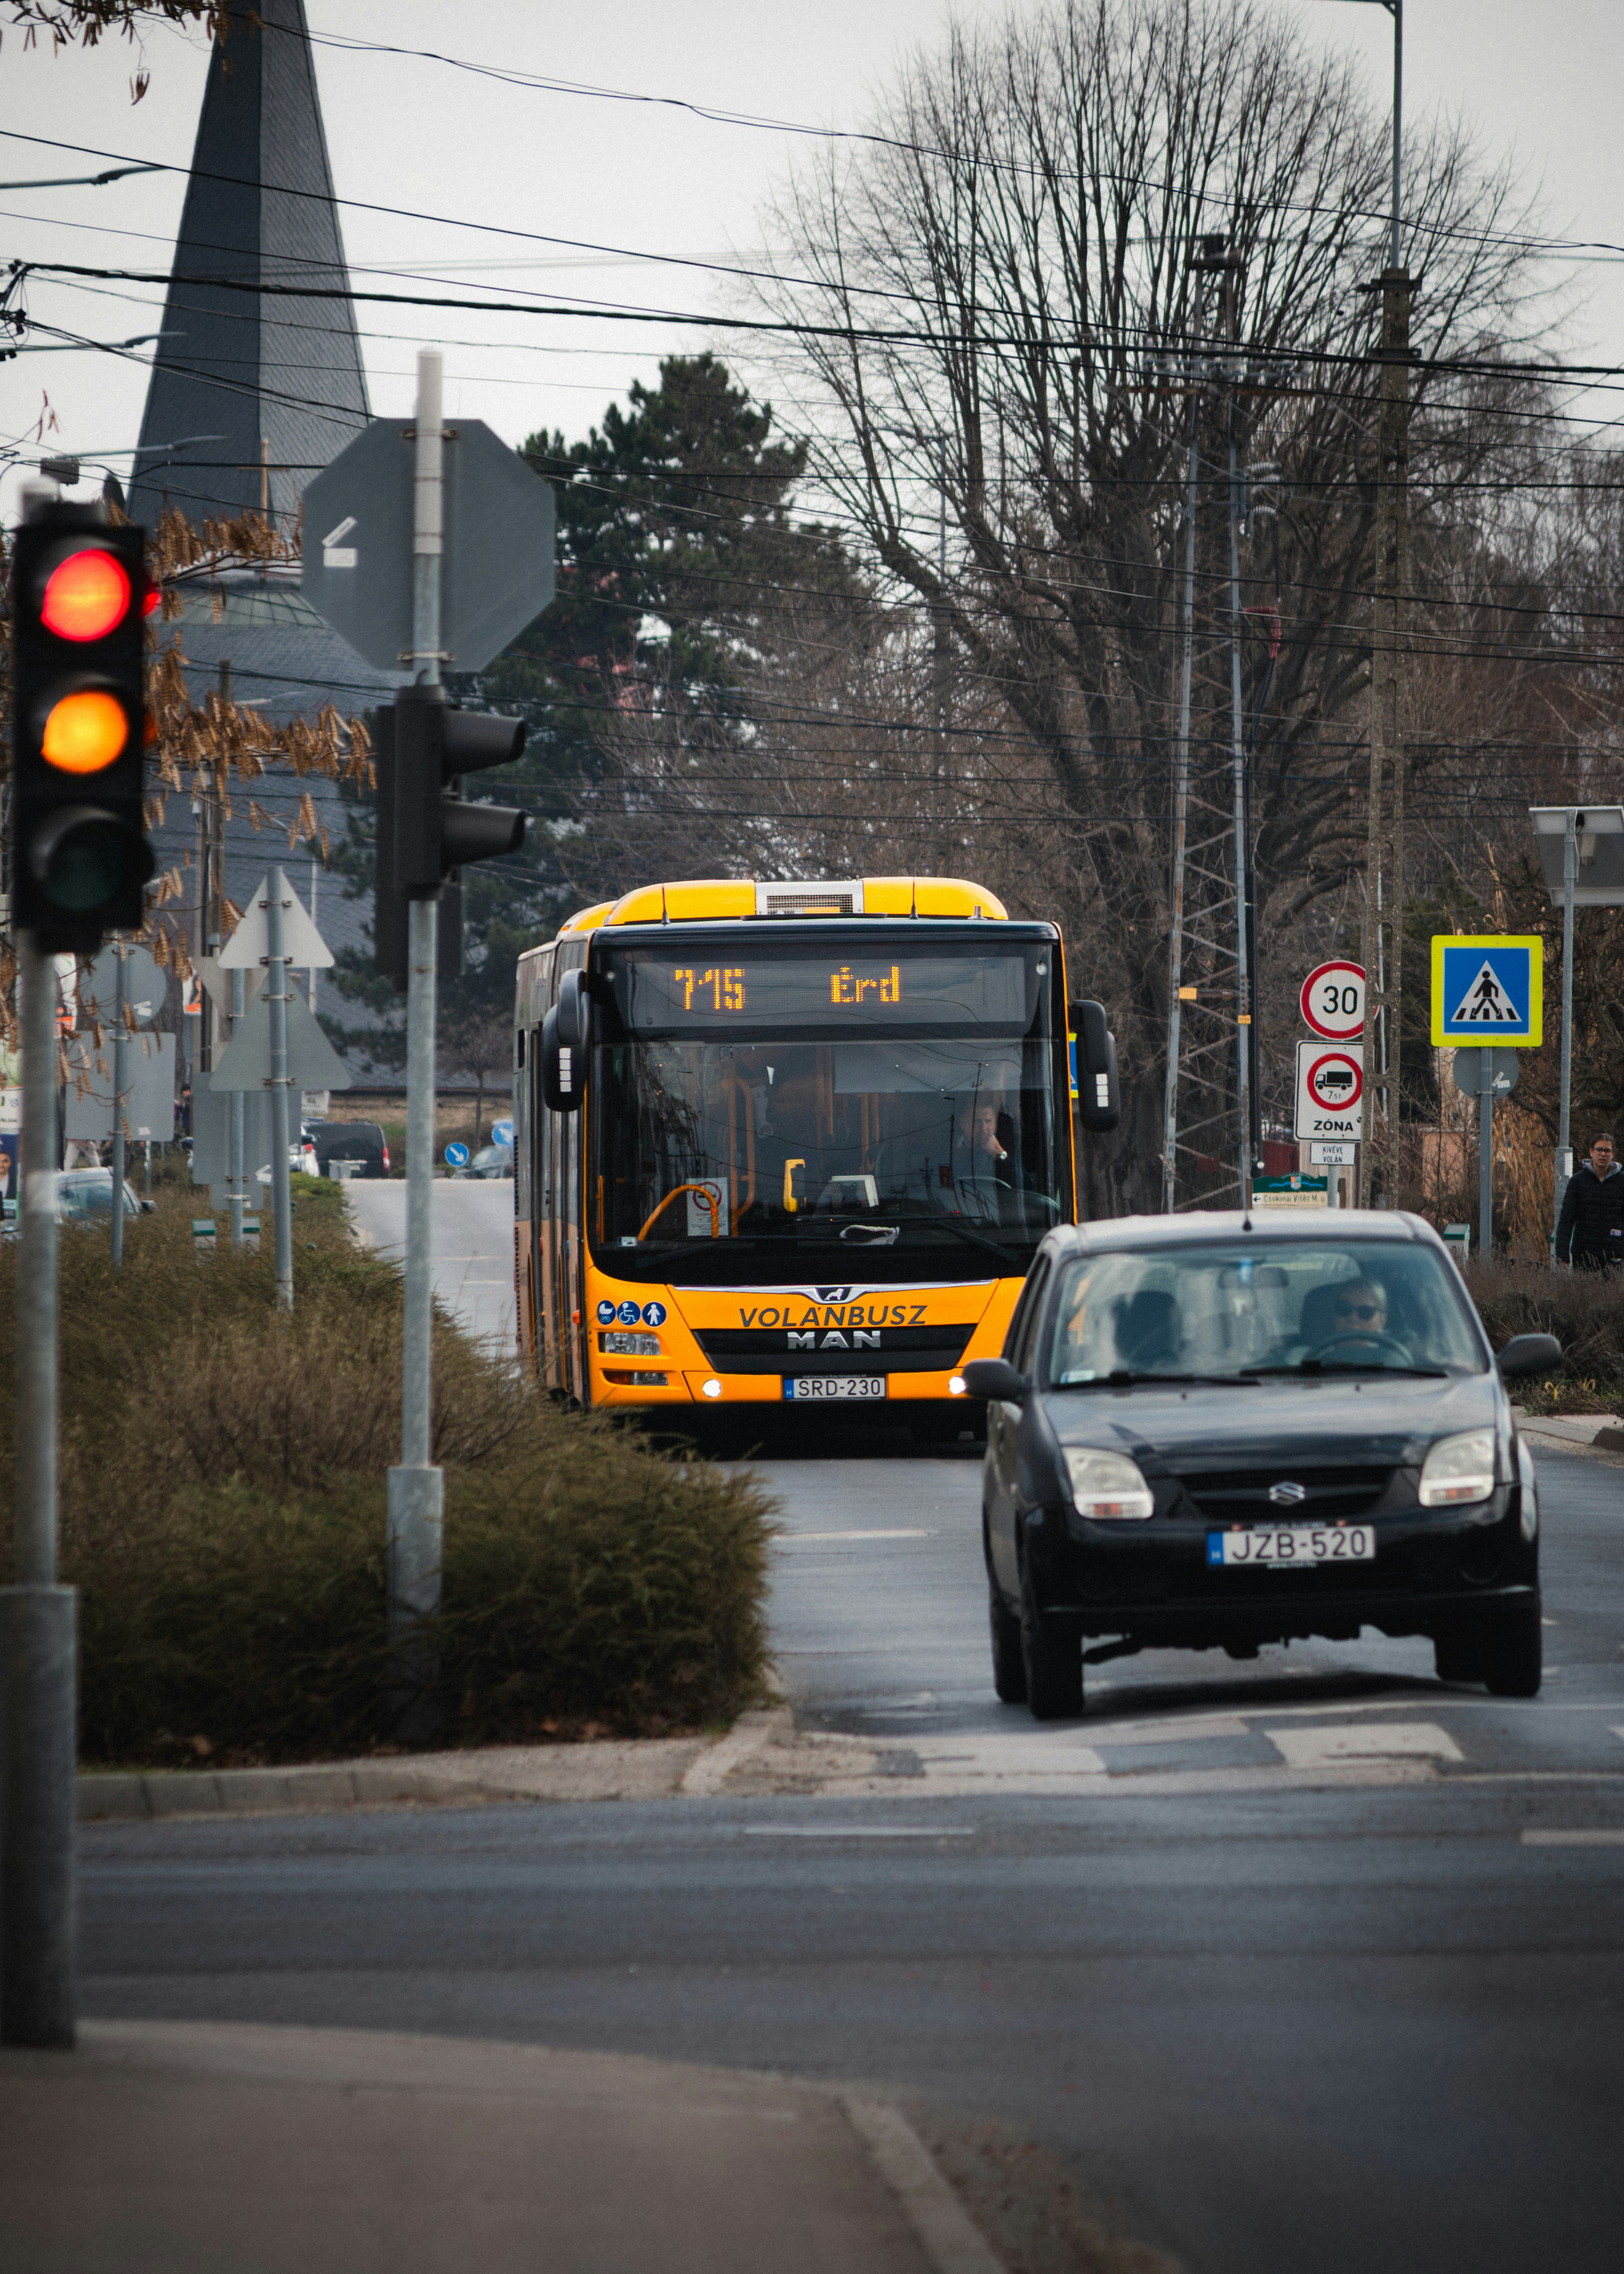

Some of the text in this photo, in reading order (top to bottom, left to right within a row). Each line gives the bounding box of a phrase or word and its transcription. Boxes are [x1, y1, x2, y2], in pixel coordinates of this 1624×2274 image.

[674, 966, 900, 1010] 715 Érd
[1323, 985, 1358, 1015] 30
[1314, 1118, 1354, 1132] ZÓNA
[1323, 1145, 1344, 1154] KIVÉVE
[1323, 1155, 1343, 1163] VOLÁN
[1264, 1194, 1292, 1203] Csokonai
[739, 1305, 928, 1328] VOLÁNBUSZ
[787, 1330, 881, 1349] MAN
[798, 1379, 880, 1396] SRD-230
[1232, 1530, 1365, 1560] JZB-520
